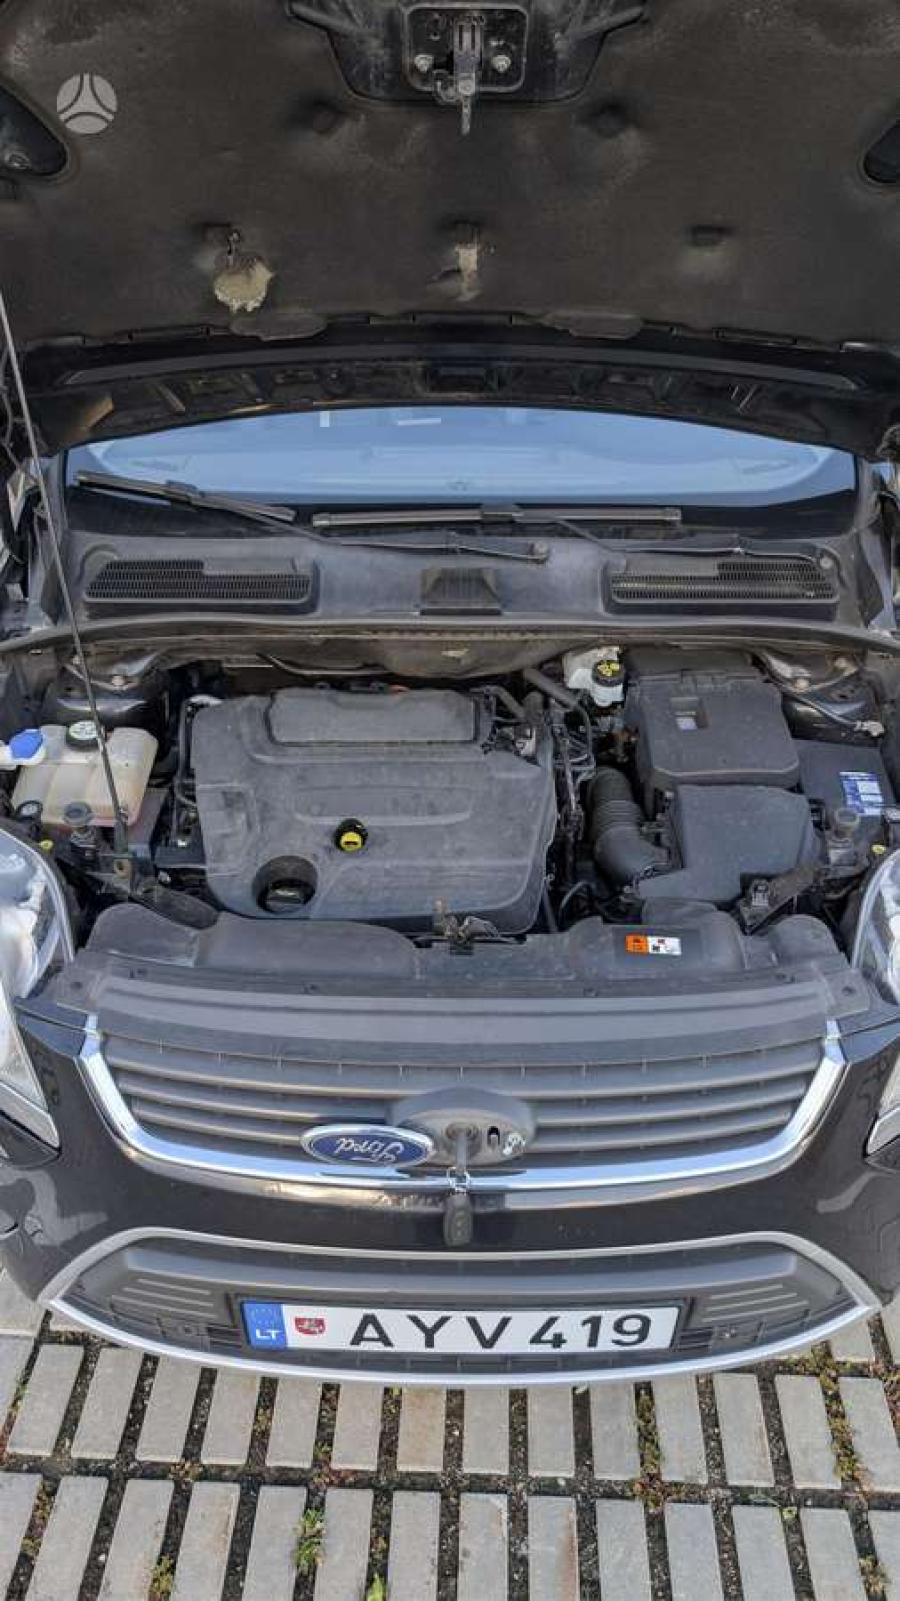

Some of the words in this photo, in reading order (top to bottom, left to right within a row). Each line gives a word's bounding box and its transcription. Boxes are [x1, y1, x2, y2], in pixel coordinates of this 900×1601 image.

[334, 1138, 405, 1162] Ford
[255, 1328, 281, 1340] LT
[350, 1313, 513, 1349] AYV
[529, 1314, 652, 1349] 419
